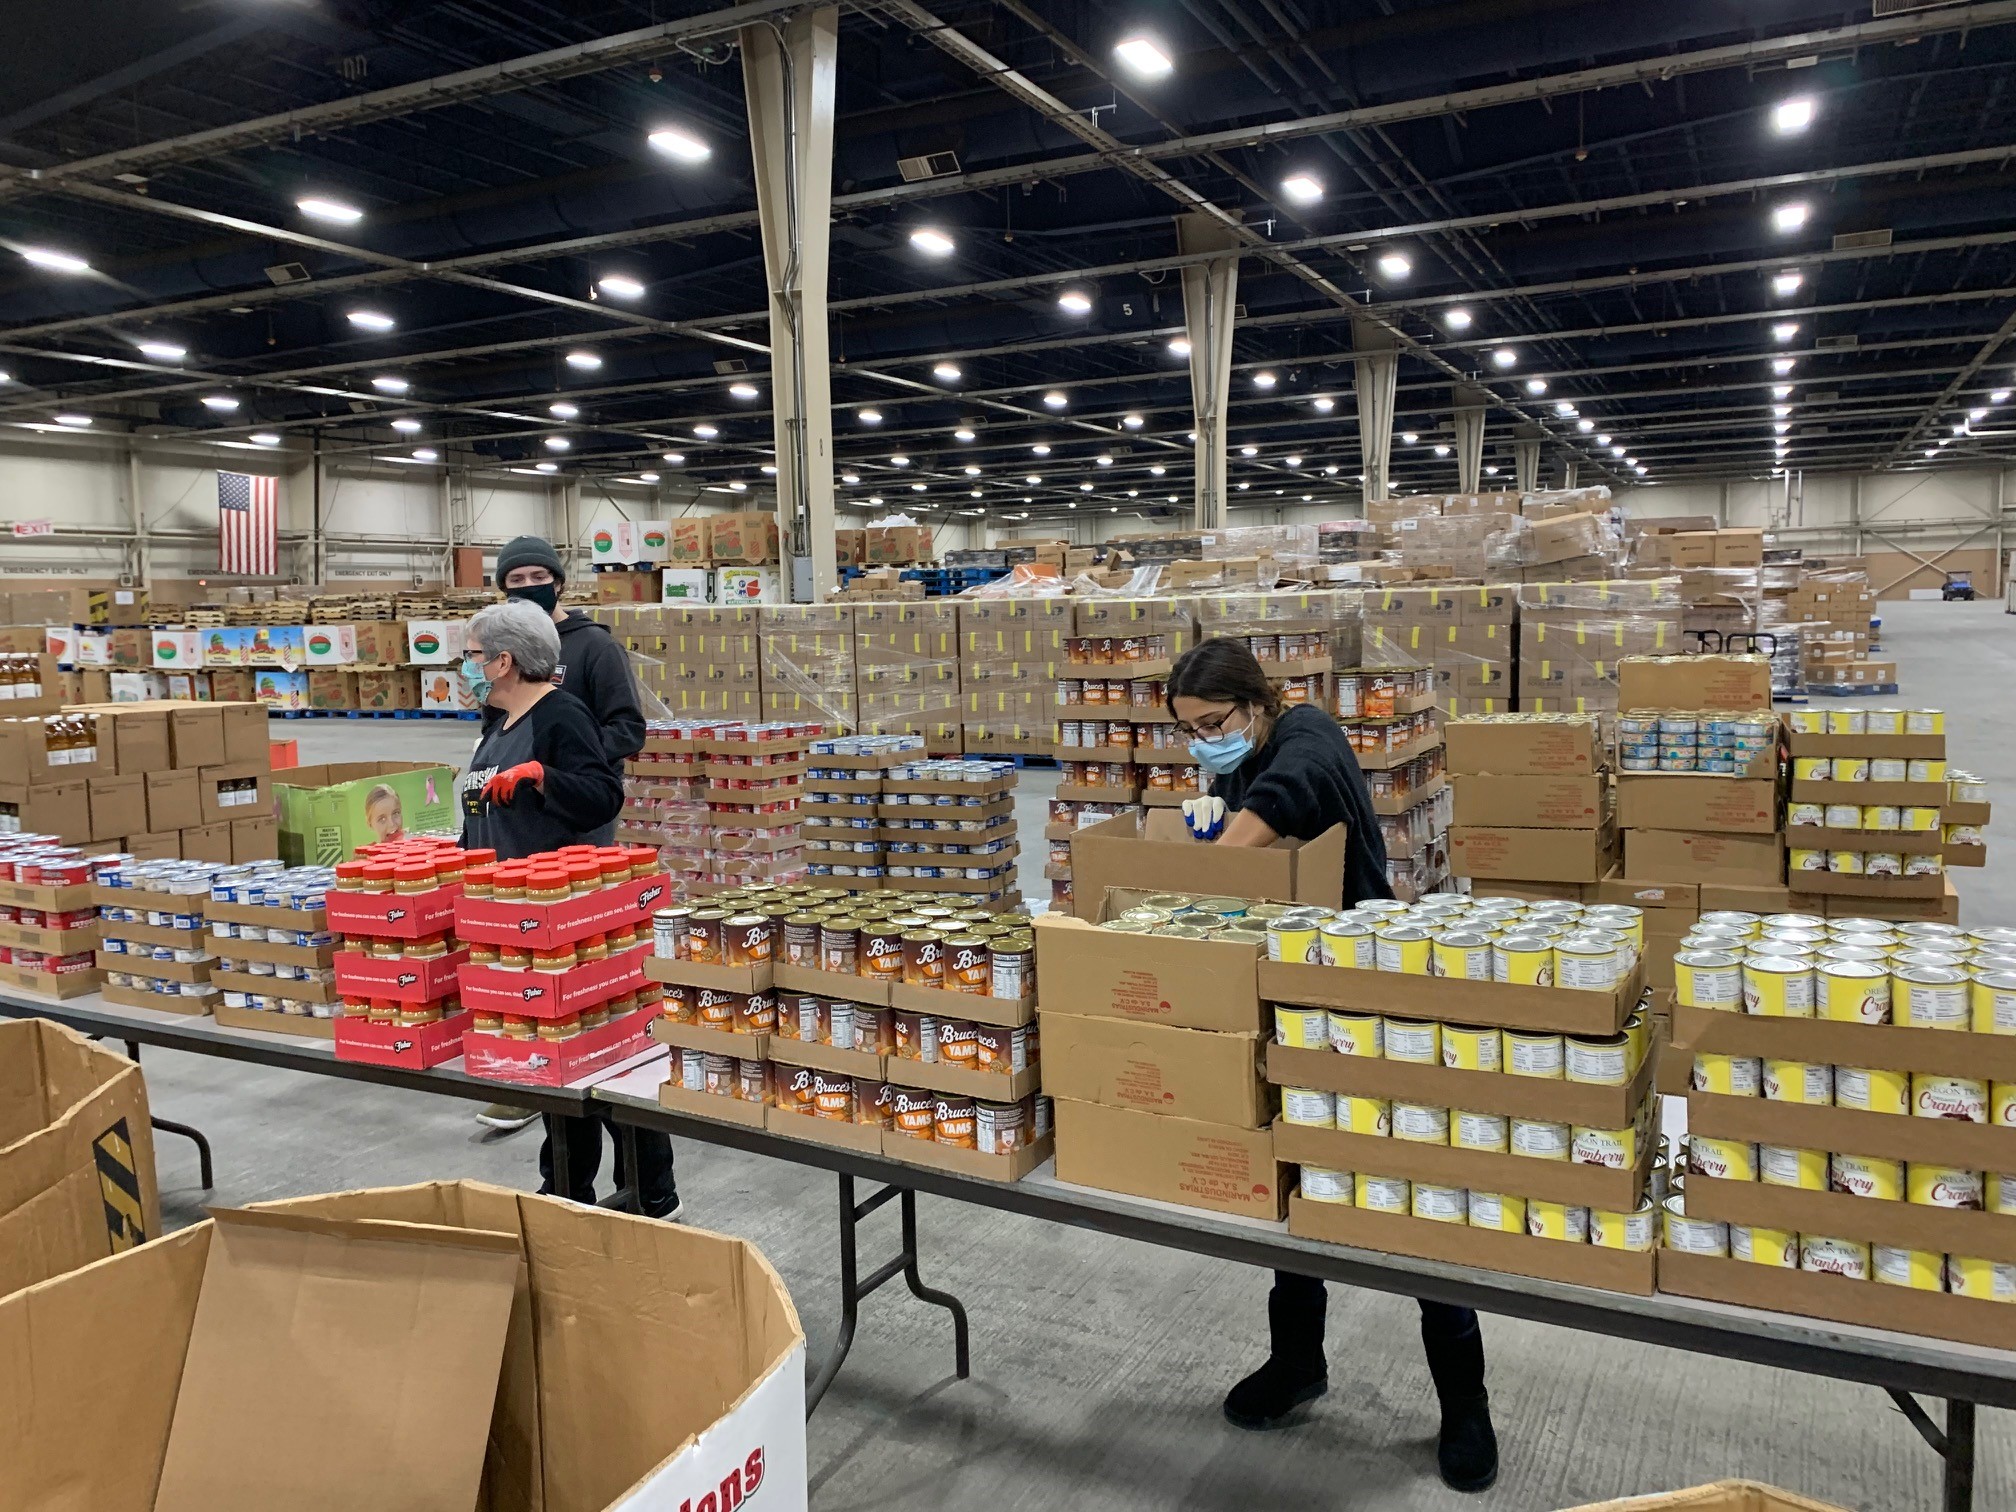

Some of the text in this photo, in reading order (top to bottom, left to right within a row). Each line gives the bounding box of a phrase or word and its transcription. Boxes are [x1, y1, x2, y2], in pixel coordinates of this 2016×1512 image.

[1123, 304, 1133, 316] 5
[556, 886, 663, 931] For freshness you can see, think Fisher
[388, 909, 406, 922] Fisher
[521, 919, 540, 933] Fisher
[867, 938, 904, 957] Bruc
[879, 957, 904, 969] YAM
[953, 948, 987, 971] Bruc
[399, 973, 417, 987] Fisher
[434, 976, 444, 985] For
[966, 967, 987, 981] YAM
[573, 985, 599, 997] freshness
[598, 981, 609, 990] you
[609, 977, 619, 985] can
[619, 974, 630, 982] see,
[629, 968, 642, 977] think
[524, 988, 543, 1001] Fisher
[663, 988, 684, 999] uce's
[698, 990, 732, 1007] Bruc
[394, 1040, 412, 1053] Fisher
[430, 1043, 441, 1052] For
[814, 1076, 852, 1095] Bruce's
[819, 1096, 846, 1109] YAMS
[935, 1101, 976, 1120] Bruce's
[903, 1113, 932, 1126] YAMS
[943, 1121, 972, 1134] YAMS
[1208, 1179, 1219, 1187] de
[1179, 1182, 1251, 1202] MARINDUSTRIAS
